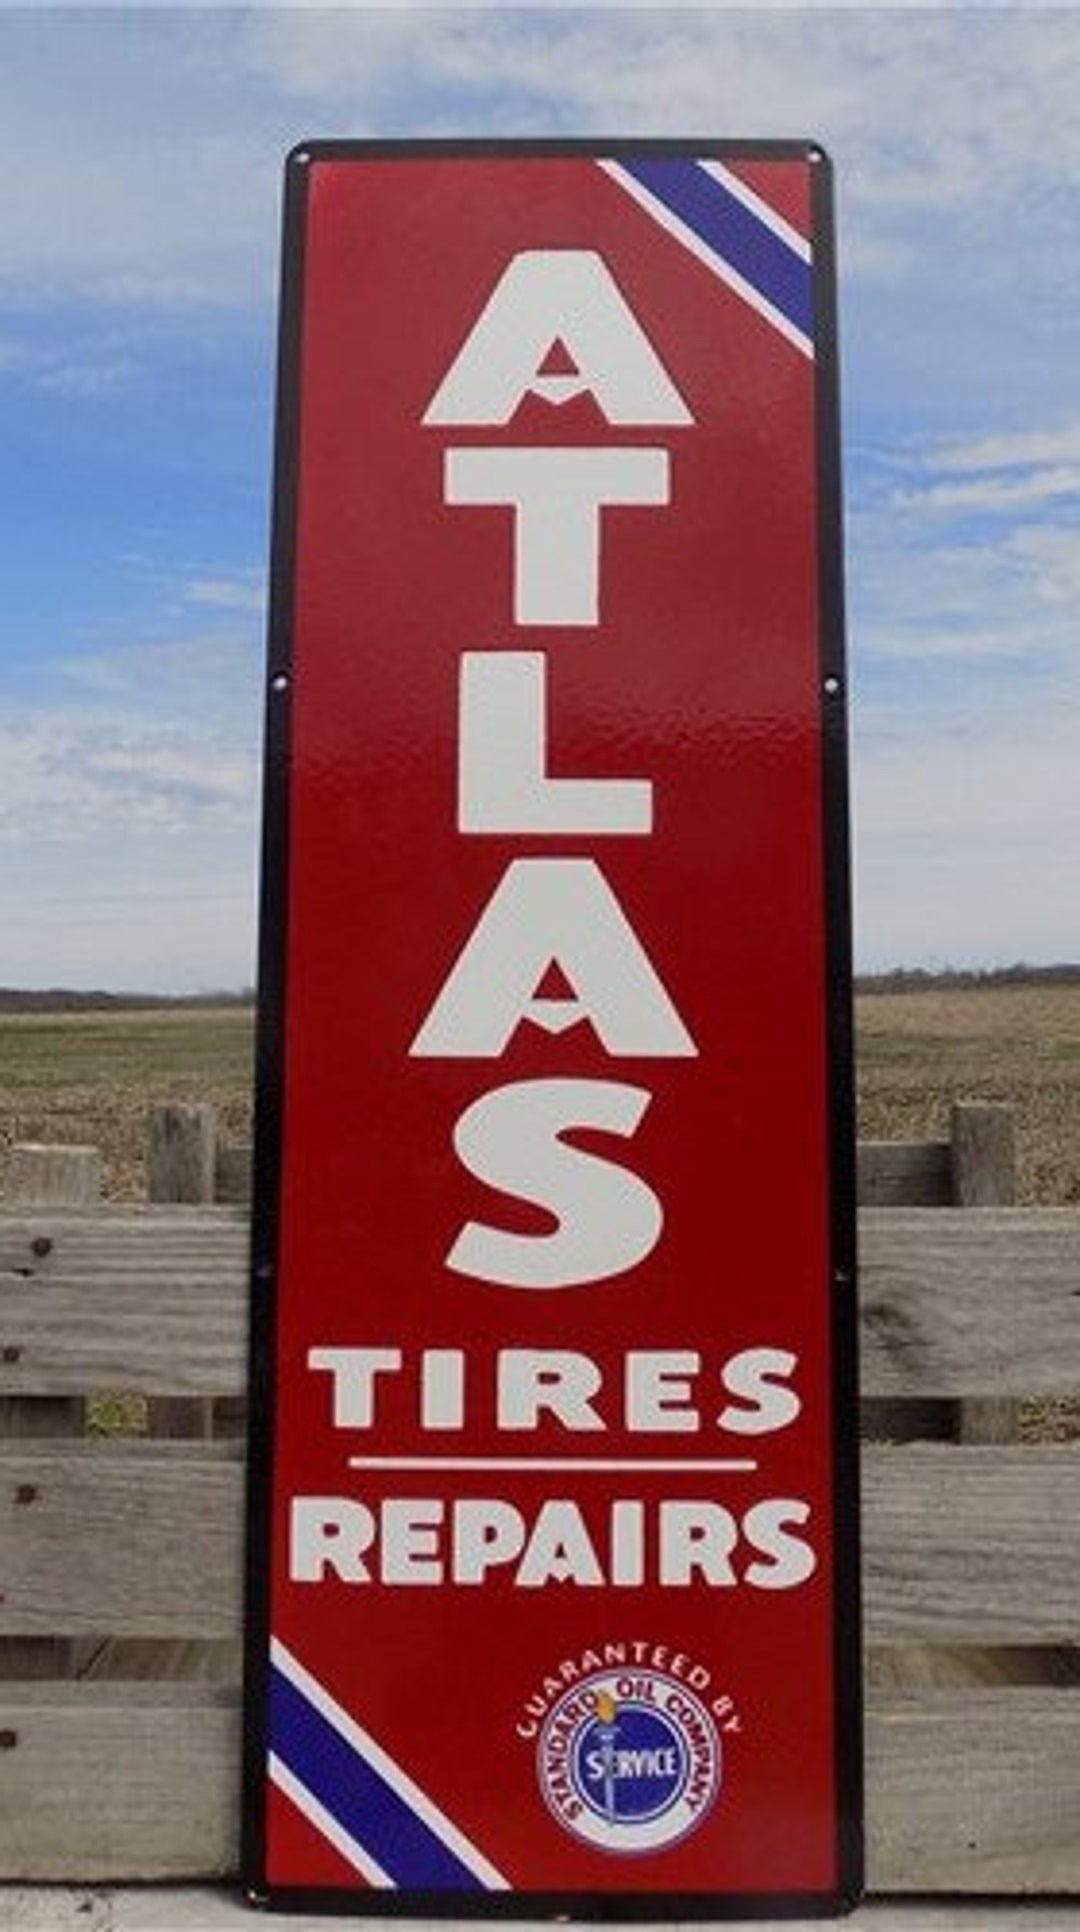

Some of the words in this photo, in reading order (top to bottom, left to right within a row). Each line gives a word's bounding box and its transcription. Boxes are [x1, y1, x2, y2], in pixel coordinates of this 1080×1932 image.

[409, 249, 697, 1289] ATLAS
[307, 1347, 802, 1433] TIRES
[288, 1496, 817, 1588] REPAIRS
[516, 1642, 711, 1738] GUARANTEED
[712, 1695, 742, 1733] BY
[548, 1690, 599, 1820] STANDARD
[616, 1677, 655, 1702] OIL
[666, 1694, 711, 1813] COMPANY
[586, 1747, 677, 1779] SERVICE
